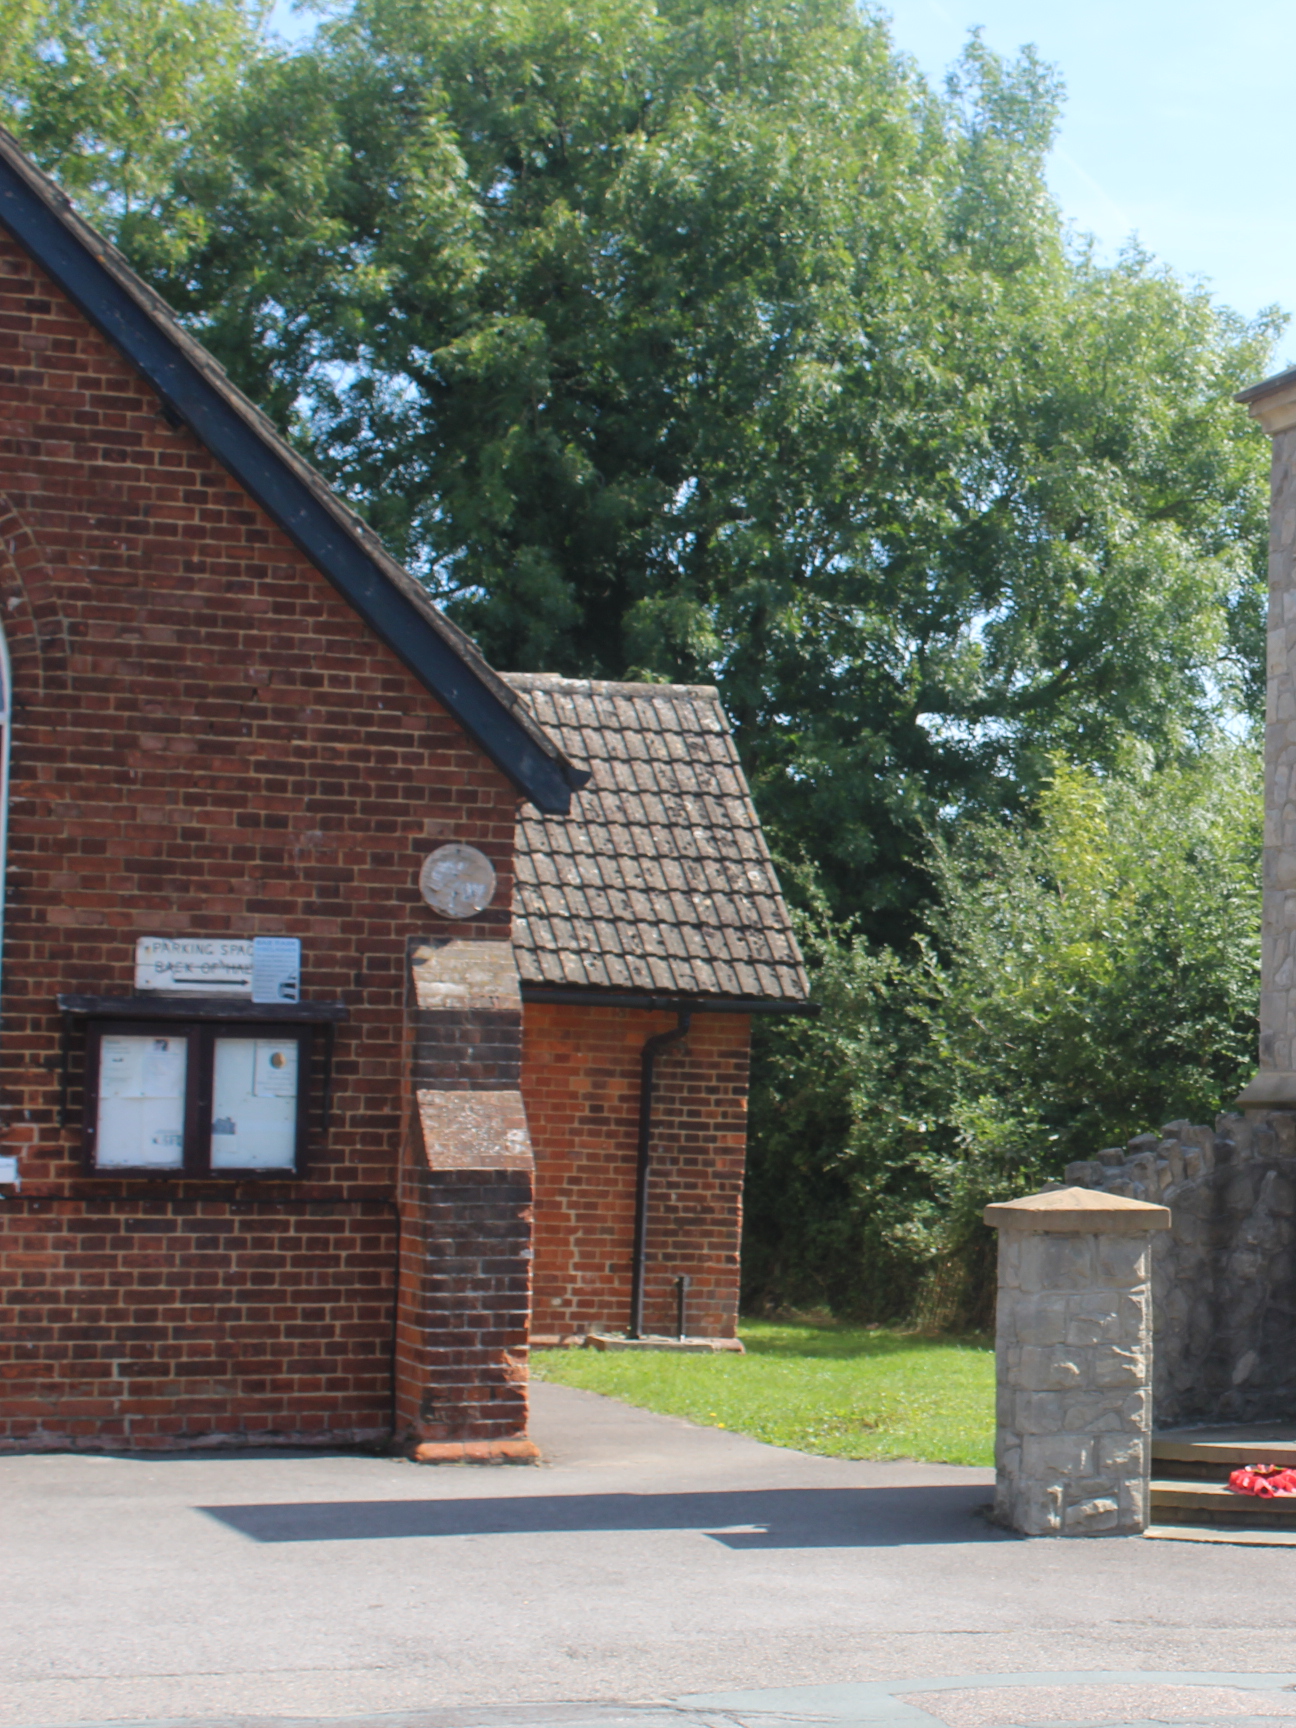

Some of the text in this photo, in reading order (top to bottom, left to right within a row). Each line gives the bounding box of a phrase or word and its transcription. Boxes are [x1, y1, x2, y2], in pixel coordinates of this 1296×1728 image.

[153, 942, 213, 954] PARKING
[155, 961, 193, 973] BACK
[201, 962, 218, 974] OF
